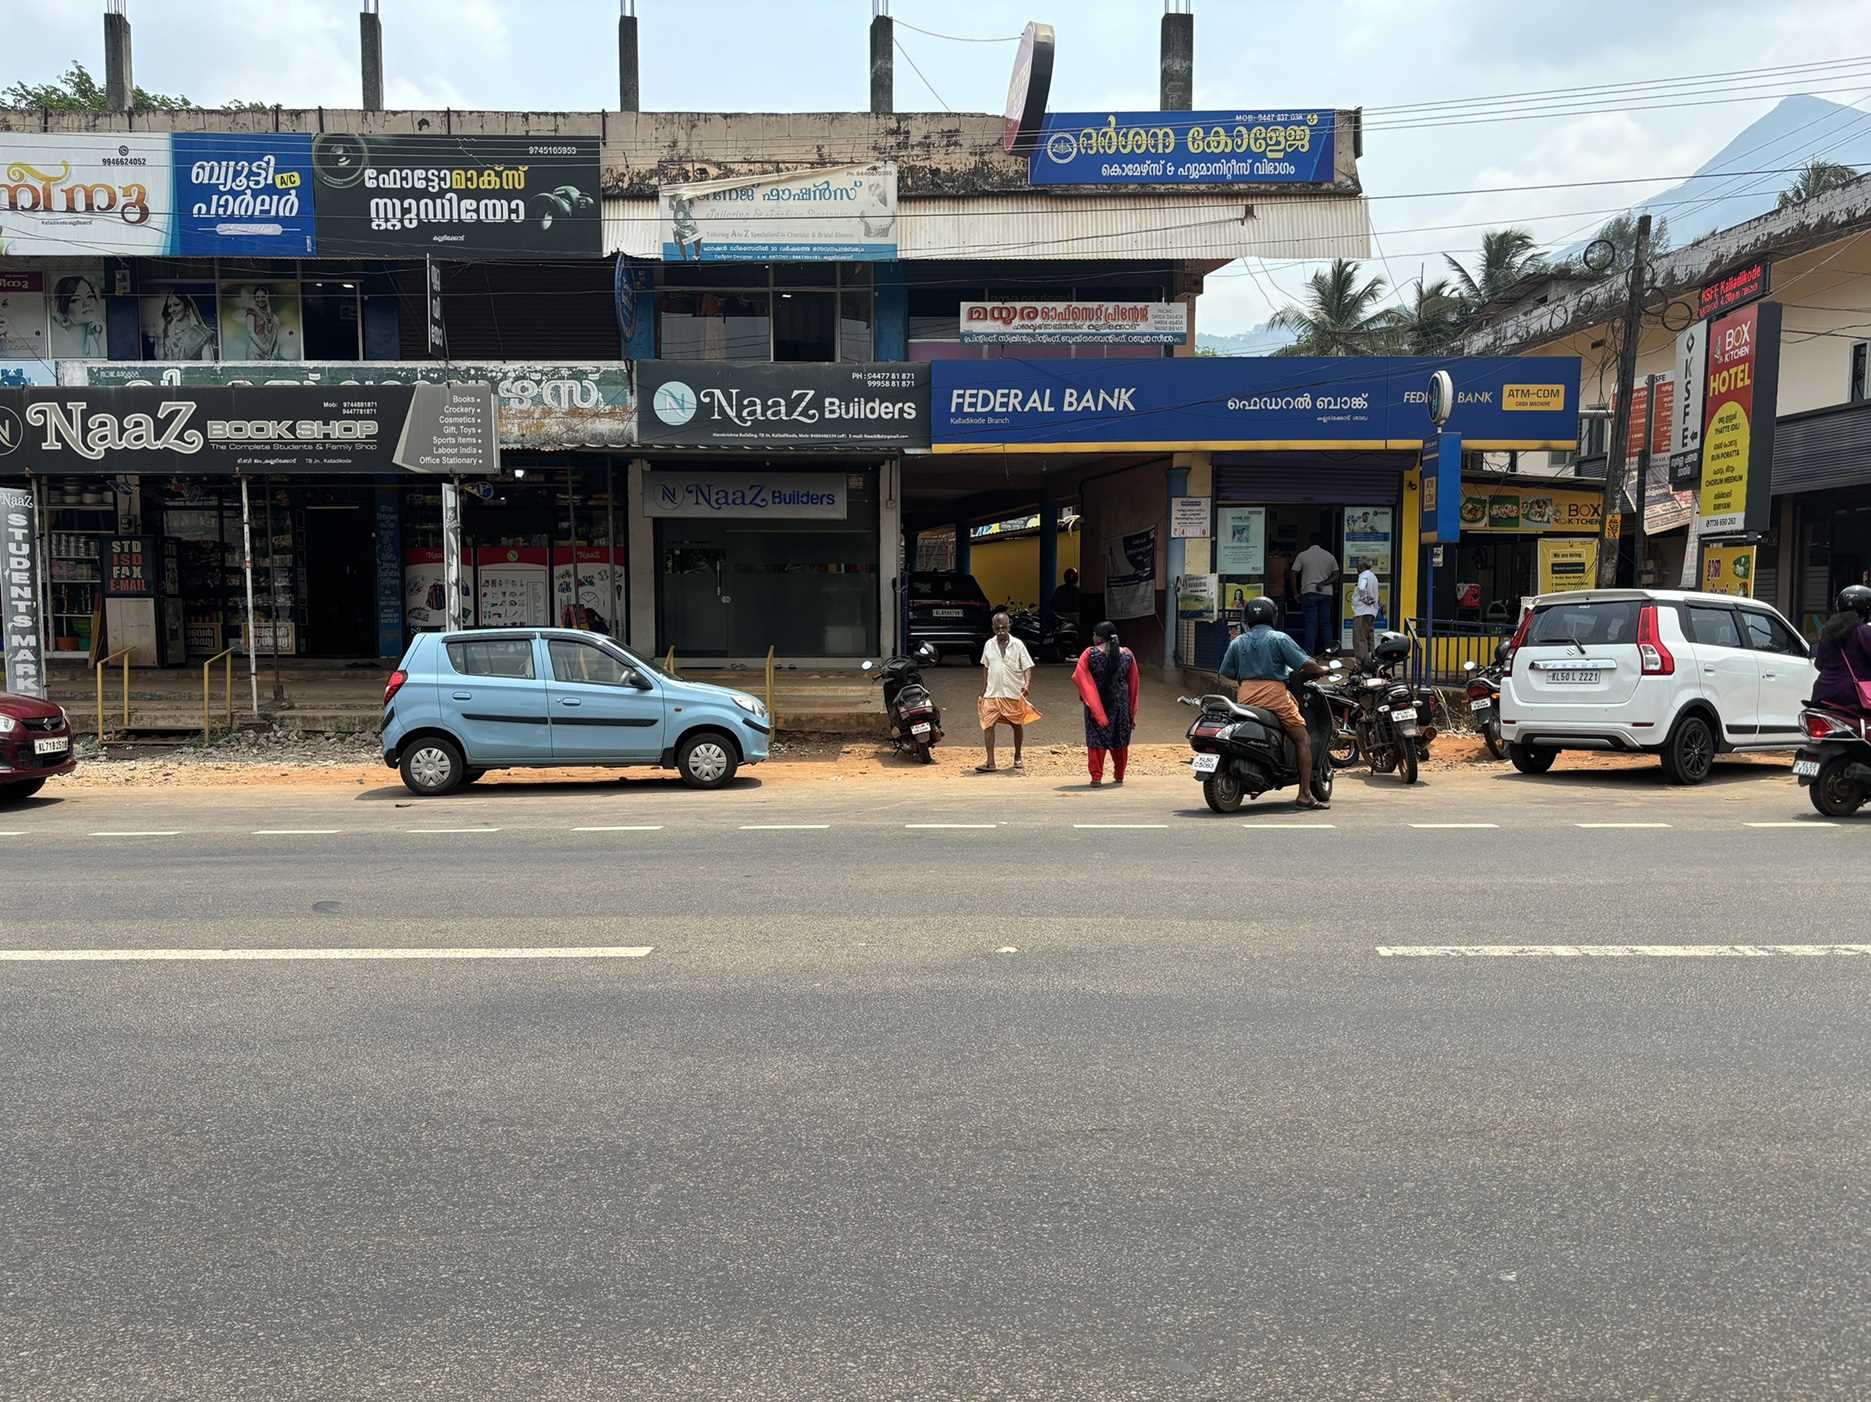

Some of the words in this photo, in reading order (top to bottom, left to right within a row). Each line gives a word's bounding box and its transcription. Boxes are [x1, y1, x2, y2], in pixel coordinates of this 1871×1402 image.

[1079, 115, 1176, 156] ദർശന
[1187, 113, 1318, 159] കോളേജ്
[102, 157, 147, 166] 9946624052
[1167, 164, 1175, 175] &
[1254, 159, 1296, 176] വിഭാഗം
[279, 174, 297, 186] A/C
[192, 190, 300, 217] പാർലർ
[1726, 321, 1751, 350] BOX
[1724, 345, 1750, 364] KITCHEN
[1709, 362, 1751, 397] HOTEL
[453, 395, 475, 403] Books
[950, 388, 1055, 413] FEDERAL
[1063, 387, 1136, 411] BANK
[1227, 393, 1312, 410] ഫെഡറൽ
[1316, 393, 1369, 409] ബാങ്ക്
[1457, 391, 1493, 403] BANK
[1681, 356, 1692, 449] KSFE
[443, 405, 476, 415] Crockery
[700, 388, 819, 427] NaaZ
[825, 397, 917, 420] Builders
[439, 416, 475, 424] Cosmetics
[26, 401, 204, 460] NaaZ
[207, 420, 295, 439] BOOK
[295, 420, 379, 439] SHOP
[459, 425, 476, 435] Toys
[432, 436, 456, 445] Sports
[229, 443, 270, 451] Complete
[325, 443, 352, 452] Family
[355, 443, 377, 451] Shop
[433, 446, 457, 454] Labour
[419, 456, 440, 465] Office
[441, 456, 478, 466] Stationary
[1, 494, 34, 509] NaaZ
[686, 484, 768, 510] NaaZ
[771, 490, 835, 506] Builders
[1568, 503, 1600, 517] BOX
[1568, 518, 1600, 526] KITCHEN
[112, 540, 142, 553] STD
[112, 554, 143, 565] ISD
[113, 566, 142, 578] FAX
[110, 579, 146, 592] E-MAIL
[1551, 671, 1570, 682] KL50
[1572, 671, 1576, 681] L
[1578, 671, 1598, 682] 2221
